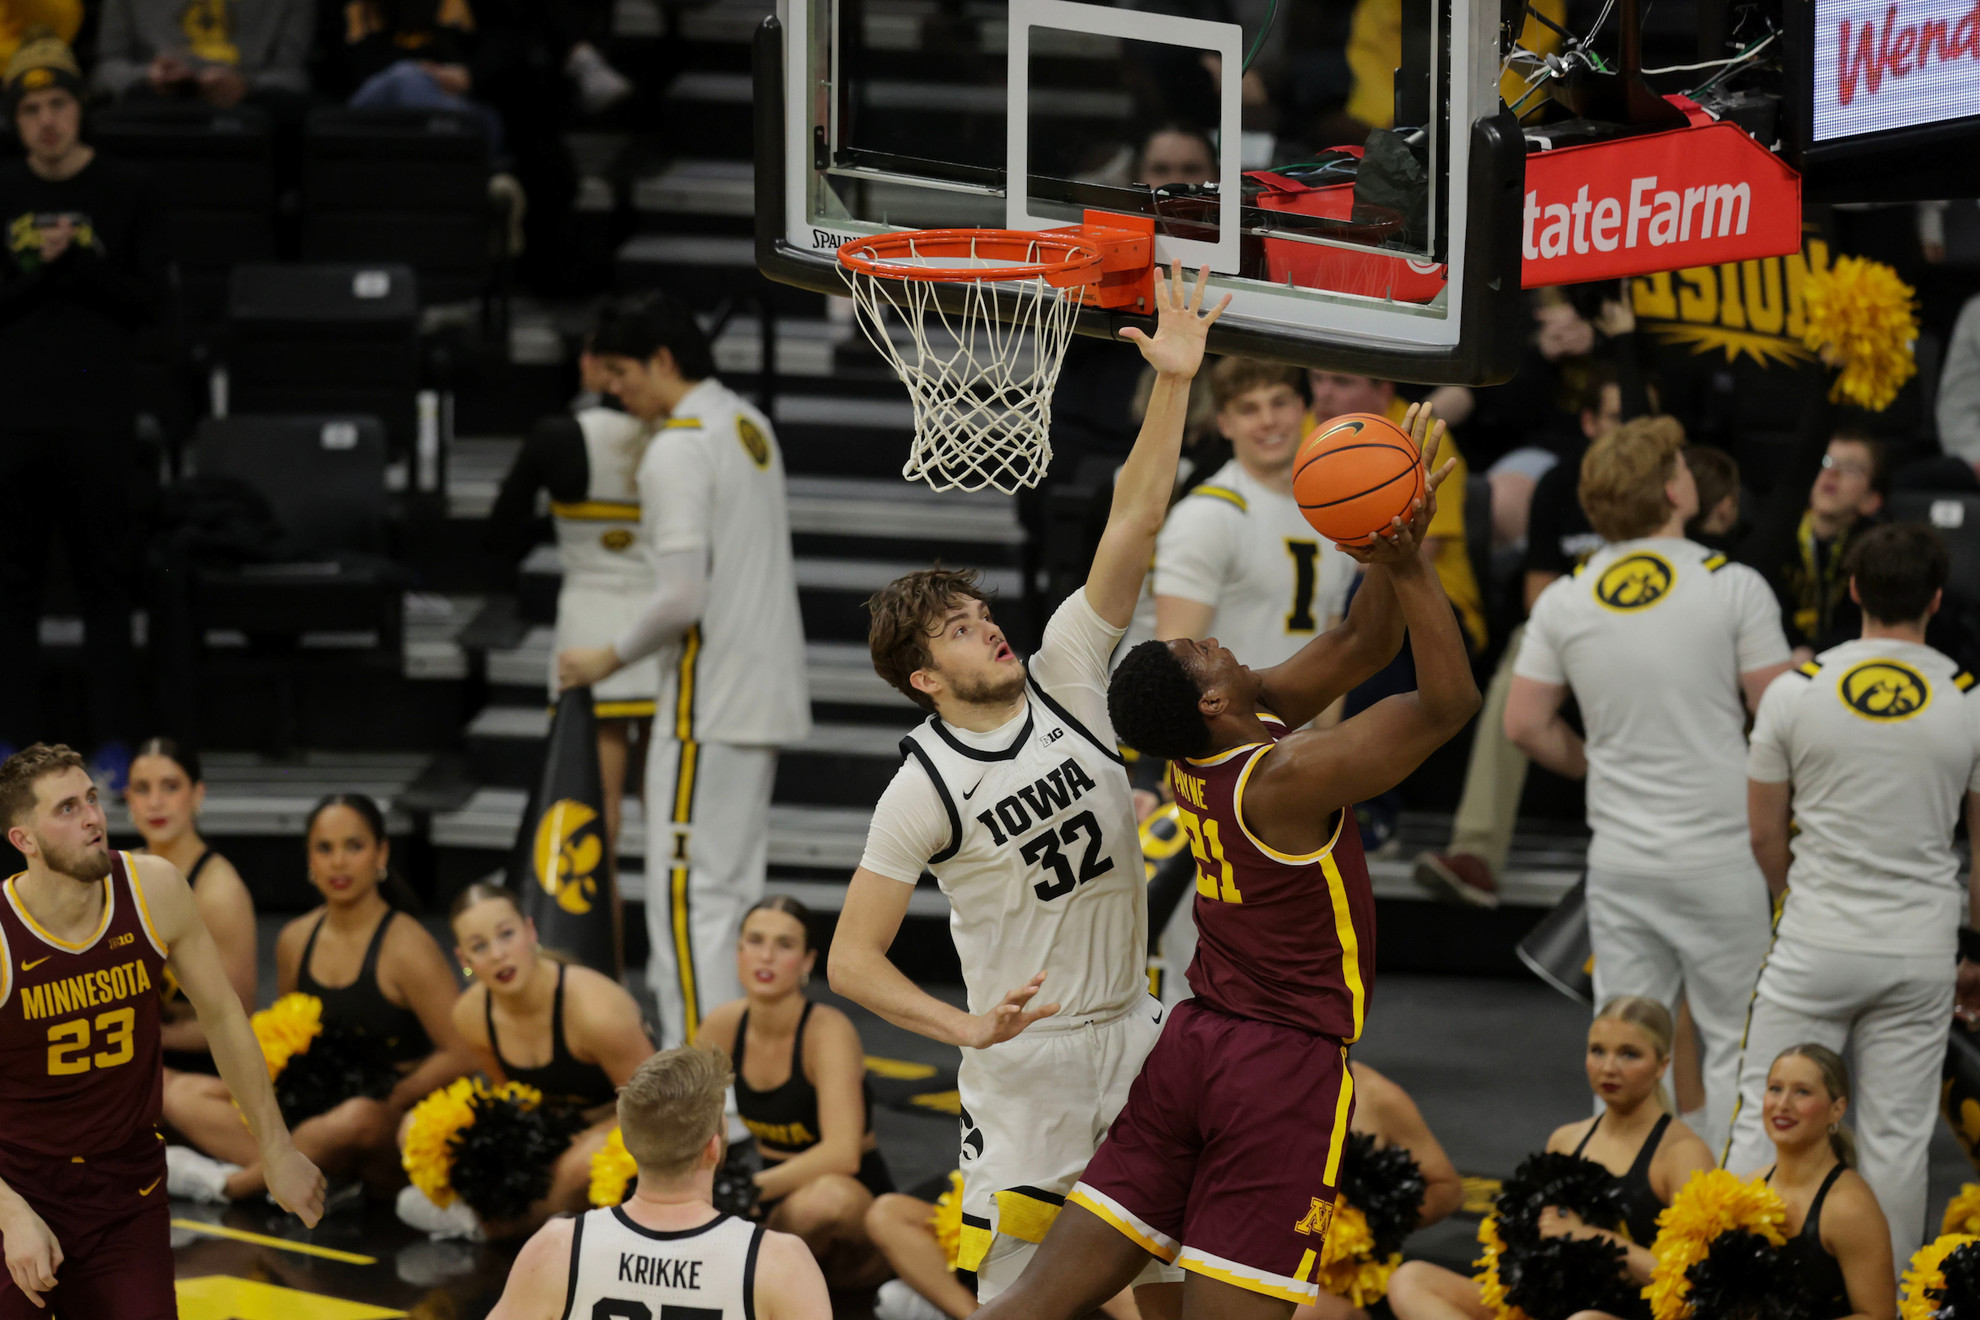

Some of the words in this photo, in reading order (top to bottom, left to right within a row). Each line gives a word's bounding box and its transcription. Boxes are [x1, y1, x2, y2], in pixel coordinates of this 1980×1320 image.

[976, 757, 1096, 847] IOWA
[1019, 810, 1114, 902] 32
[1178, 805, 1243, 904] 21
[20, 959, 151, 1020] MINNESOTA
[47, 1007, 135, 1076] 23
[618, 1252, 703, 1290] KRIKKE
